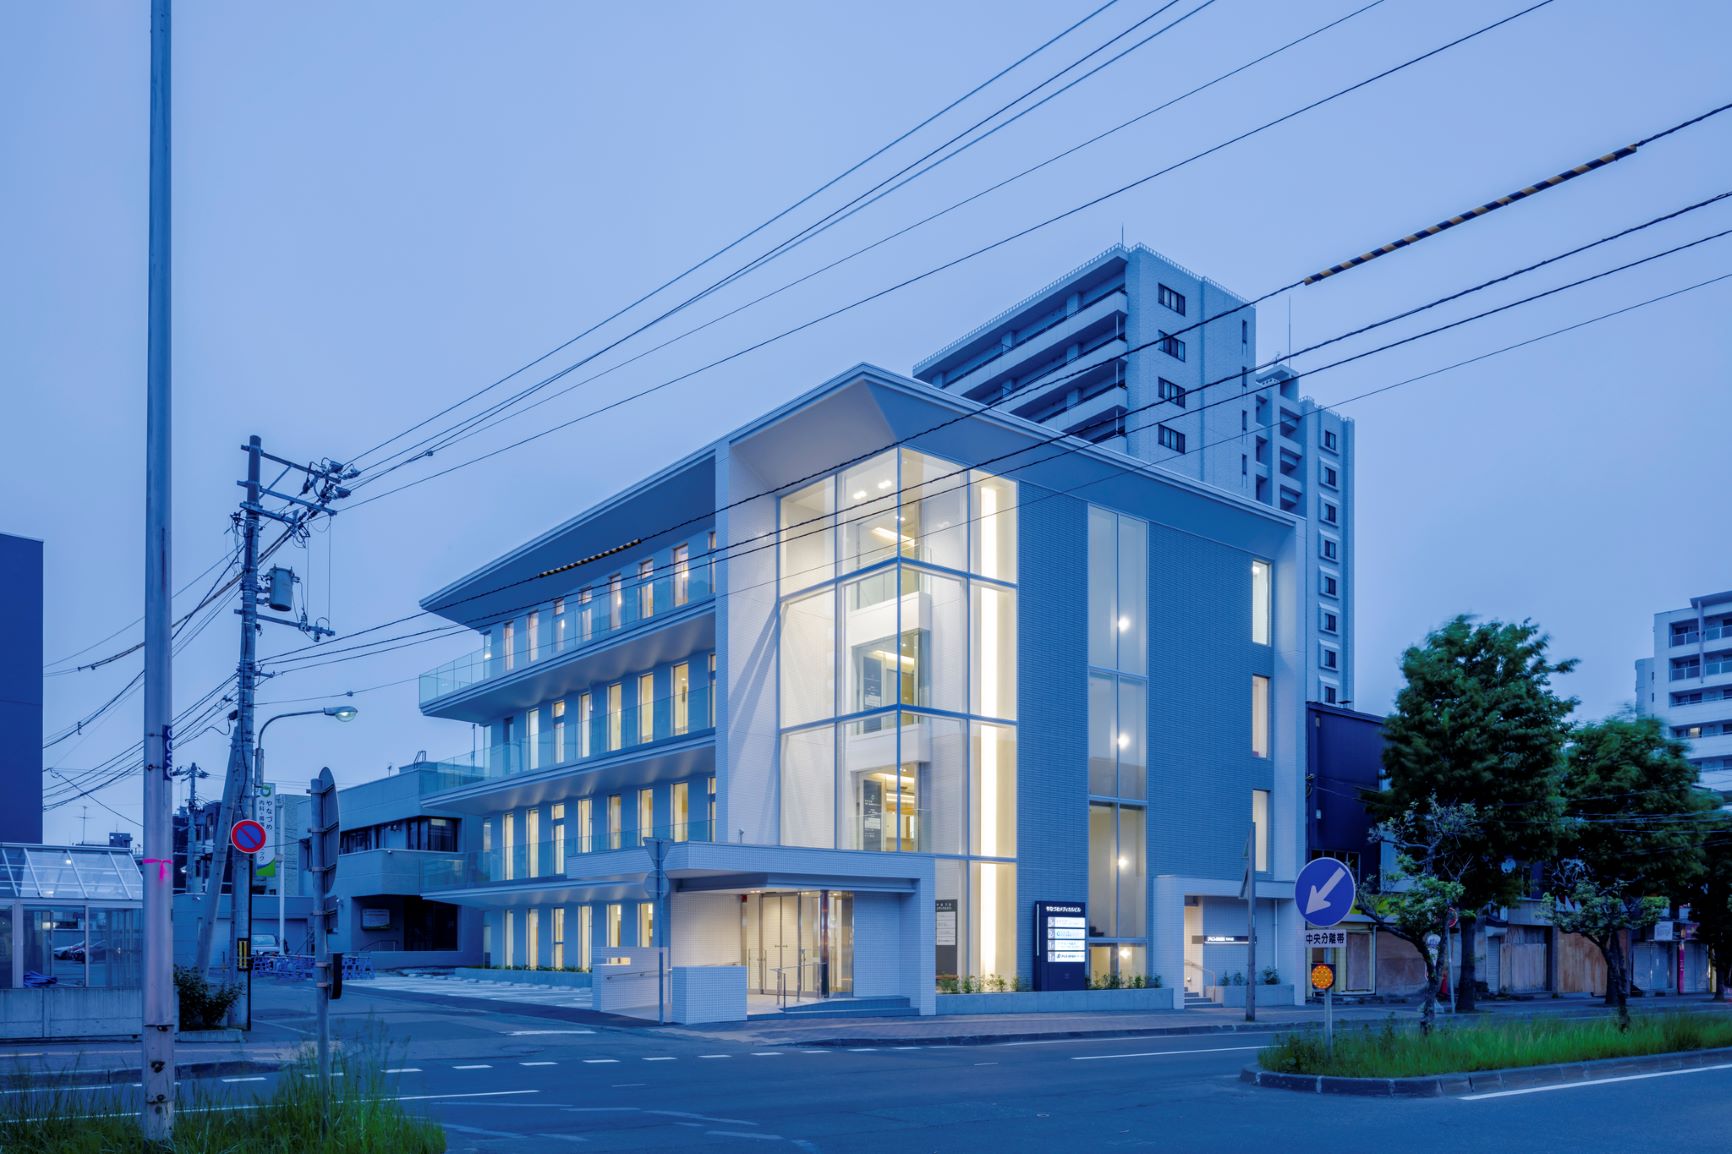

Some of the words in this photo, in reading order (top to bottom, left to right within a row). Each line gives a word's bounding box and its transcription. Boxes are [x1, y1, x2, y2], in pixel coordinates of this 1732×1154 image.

[1305, 932, 1345, 944] 中央分離帯
